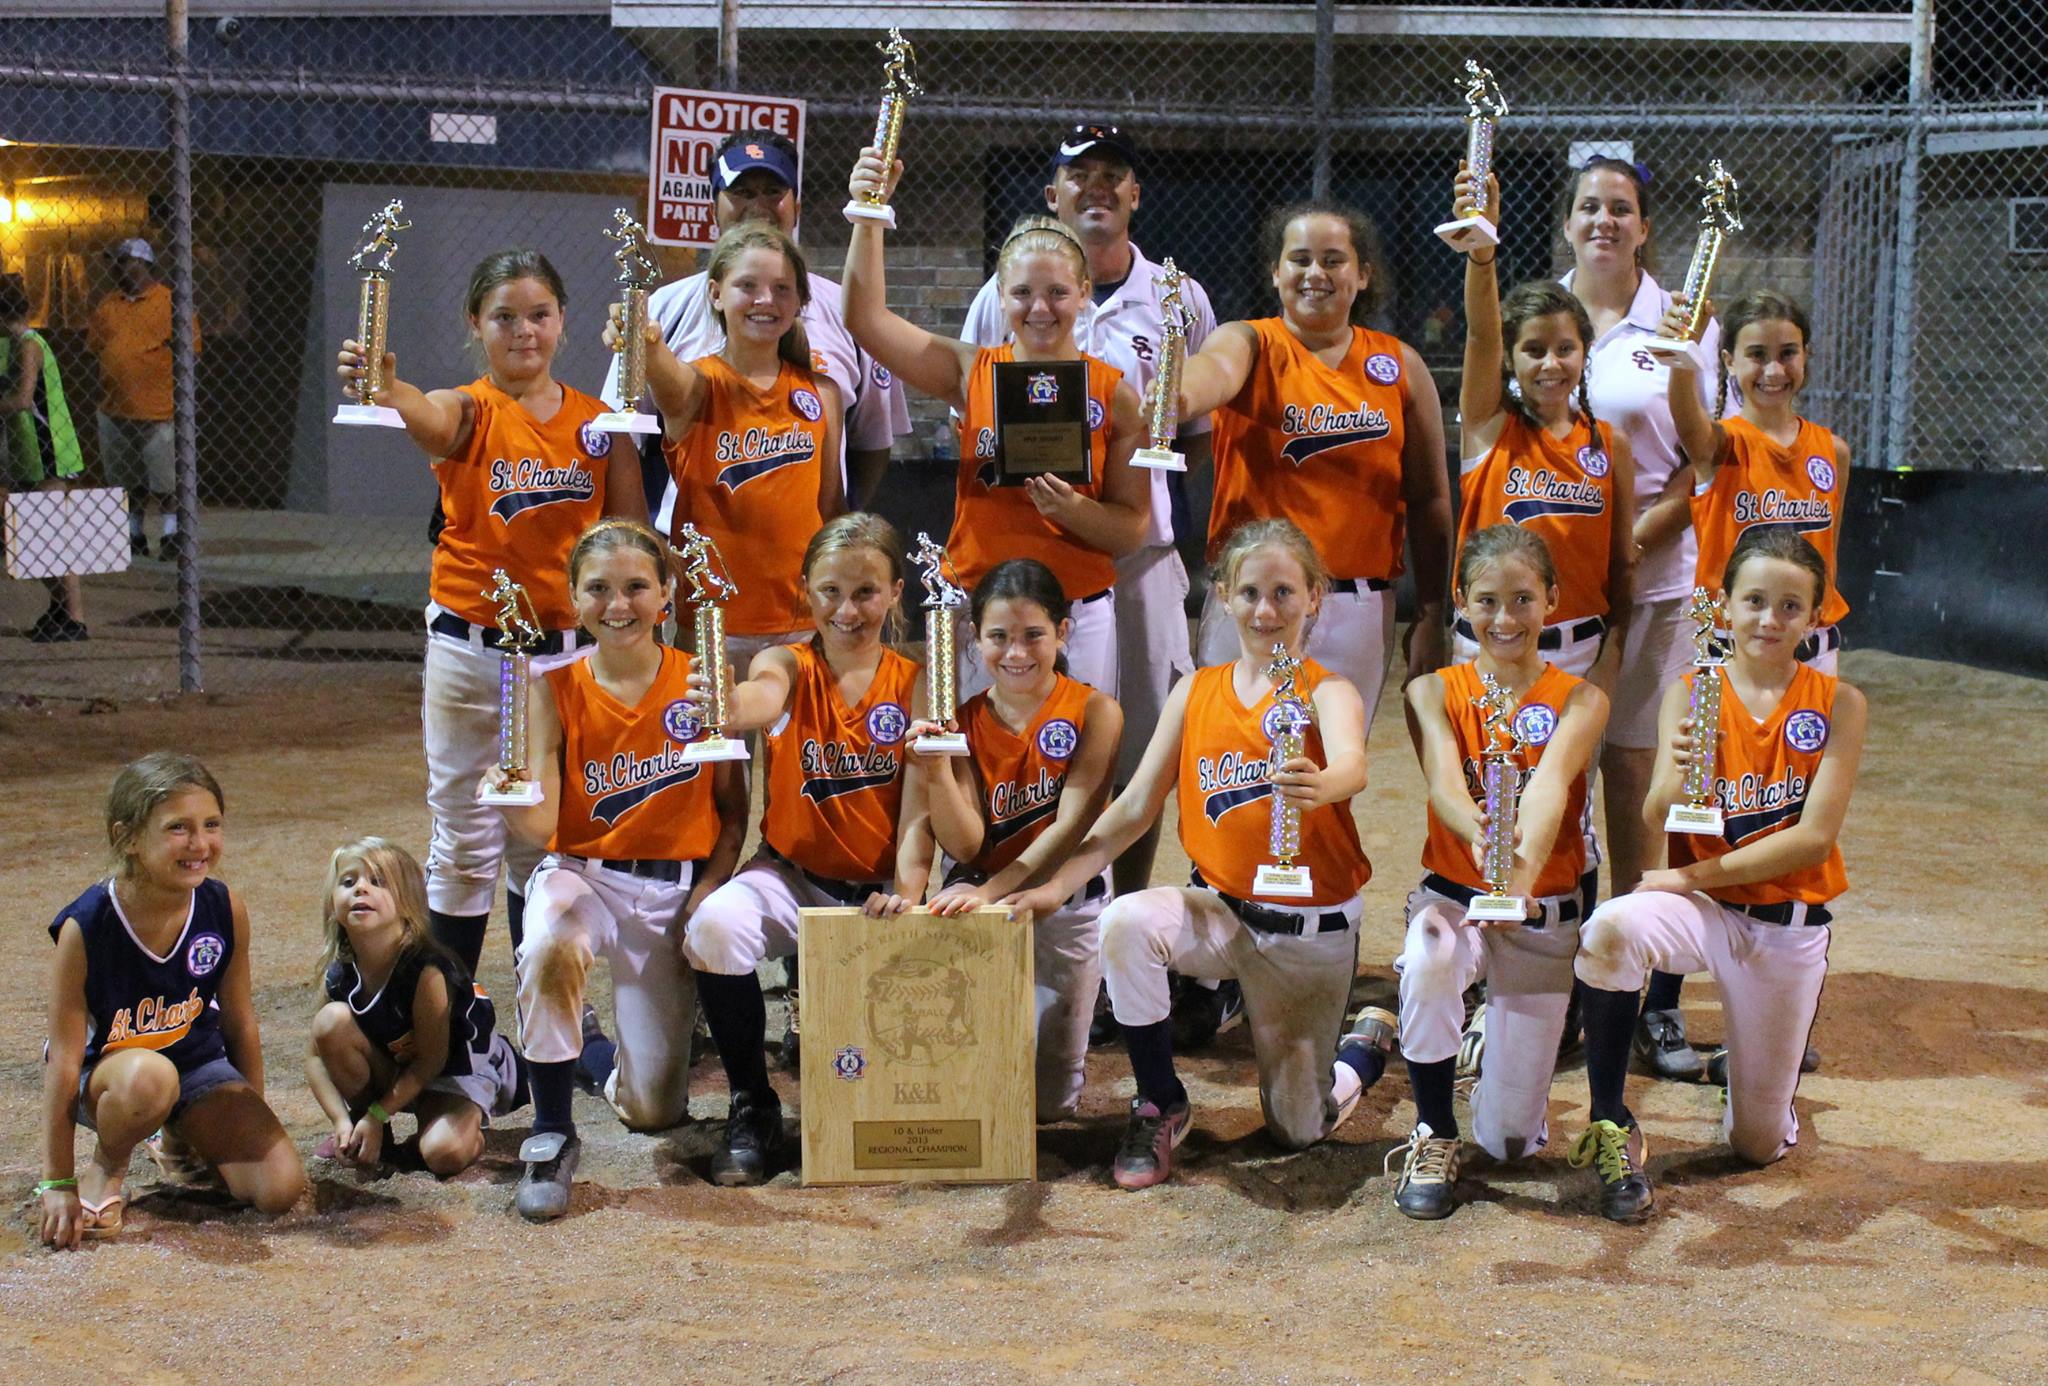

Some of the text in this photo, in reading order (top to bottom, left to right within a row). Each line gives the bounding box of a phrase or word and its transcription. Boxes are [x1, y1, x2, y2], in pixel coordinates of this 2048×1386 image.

[669, 98, 790, 135] NOTICE
[662, 181, 711, 200] AGAIN
[662, 203, 708, 222] PARK
[679, 222, 701, 239] AT
[1131, 335, 1153, 361] SC
[1632, 350, 1654, 371] SC
[1309, 401, 1390, 433] Charles
[743, 422, 816, 458] Charles
[515, 457, 594, 490] Charles
[1529, 466, 1603, 505] Charles
[1760, 488, 1832, 520] Charles
[612, 740, 697, 789] Charle
[821, 741, 899, 776] Charles
[868, 1145, 968, 1154] REGIONAL CHAMPION
